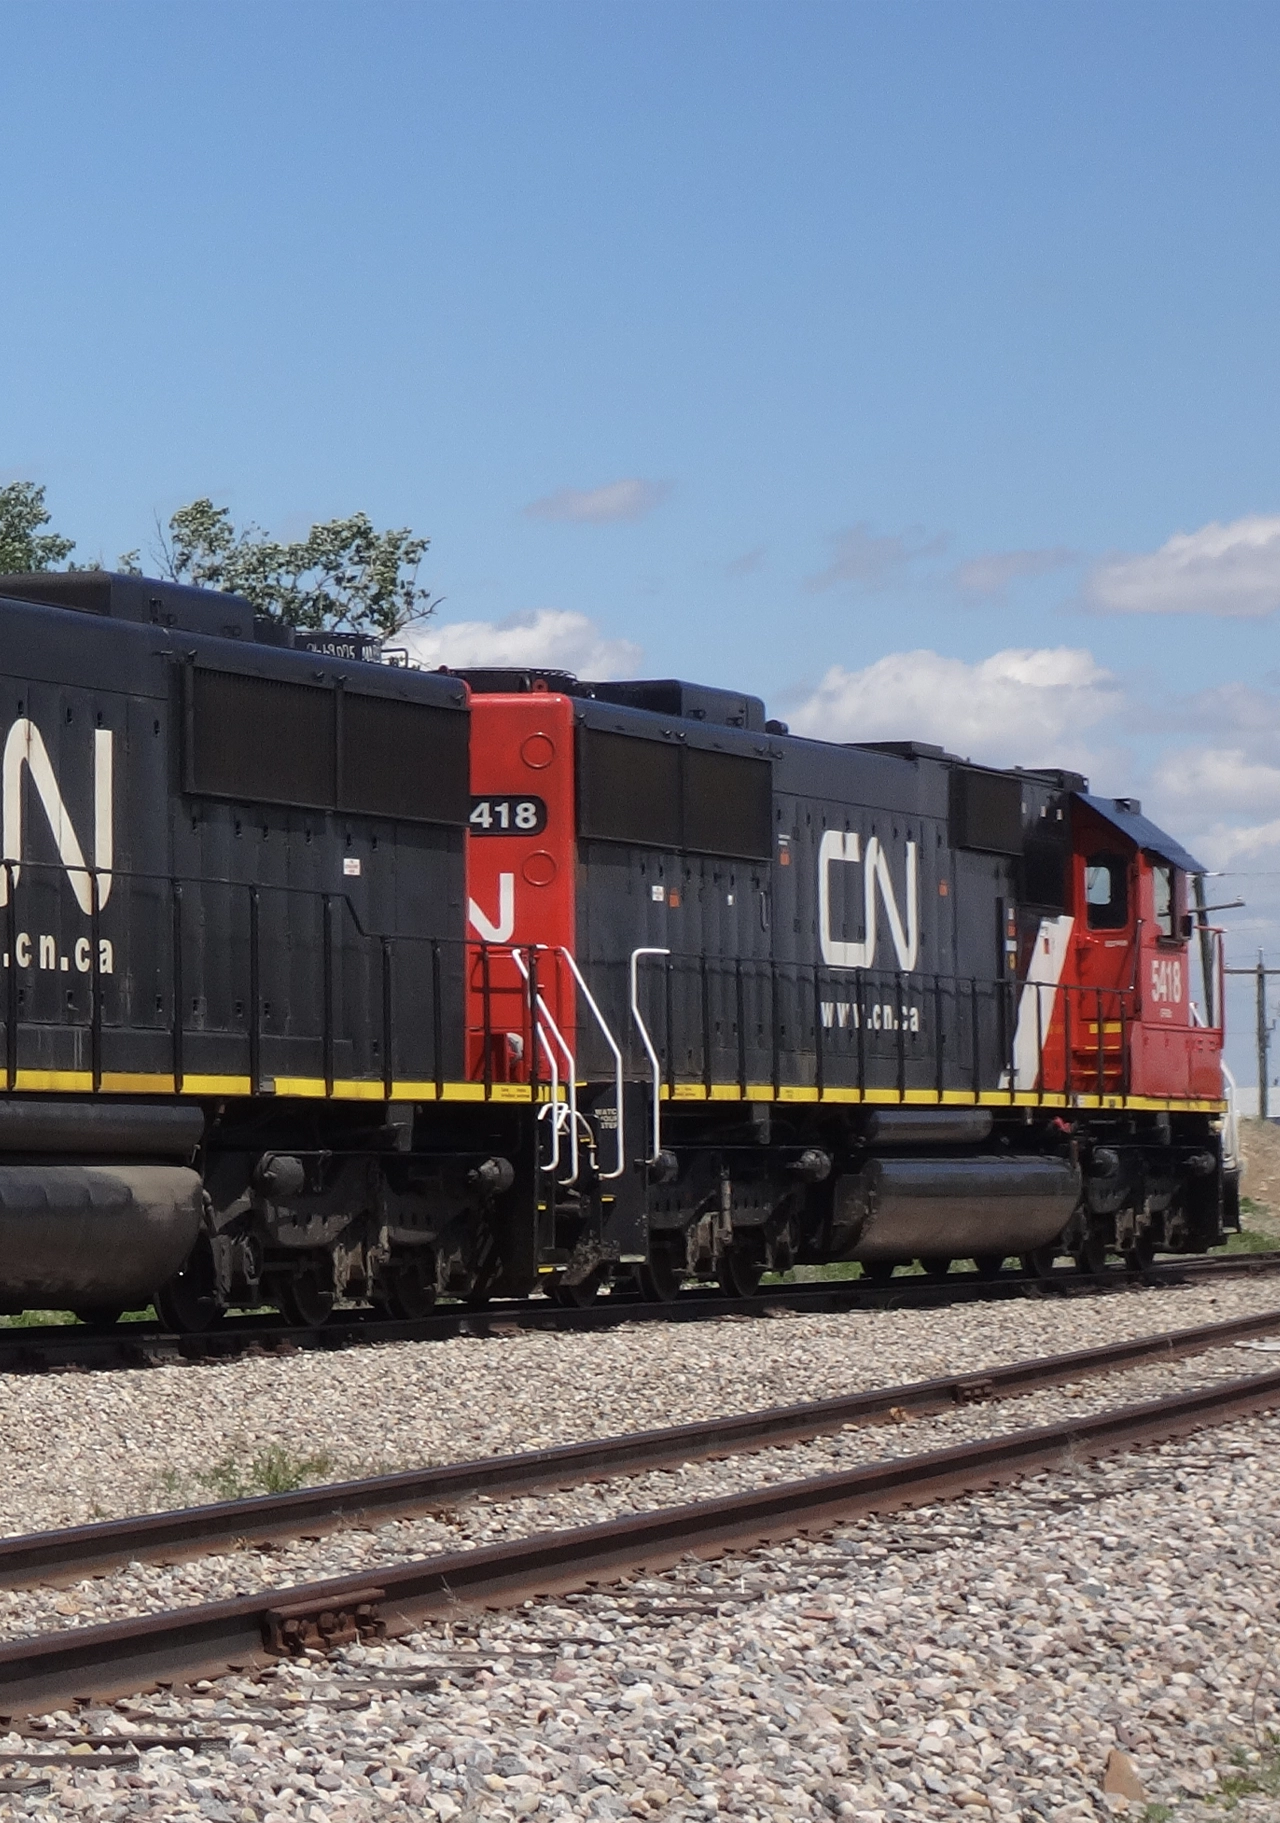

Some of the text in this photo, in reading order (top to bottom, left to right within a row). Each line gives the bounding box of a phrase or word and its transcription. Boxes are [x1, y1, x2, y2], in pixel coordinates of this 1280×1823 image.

[470, 802, 538, 829] 418
[470, 872, 515, 944] N
[818, 830, 917, 976] CN
[1151, 960, 1182, 1003] 5418
